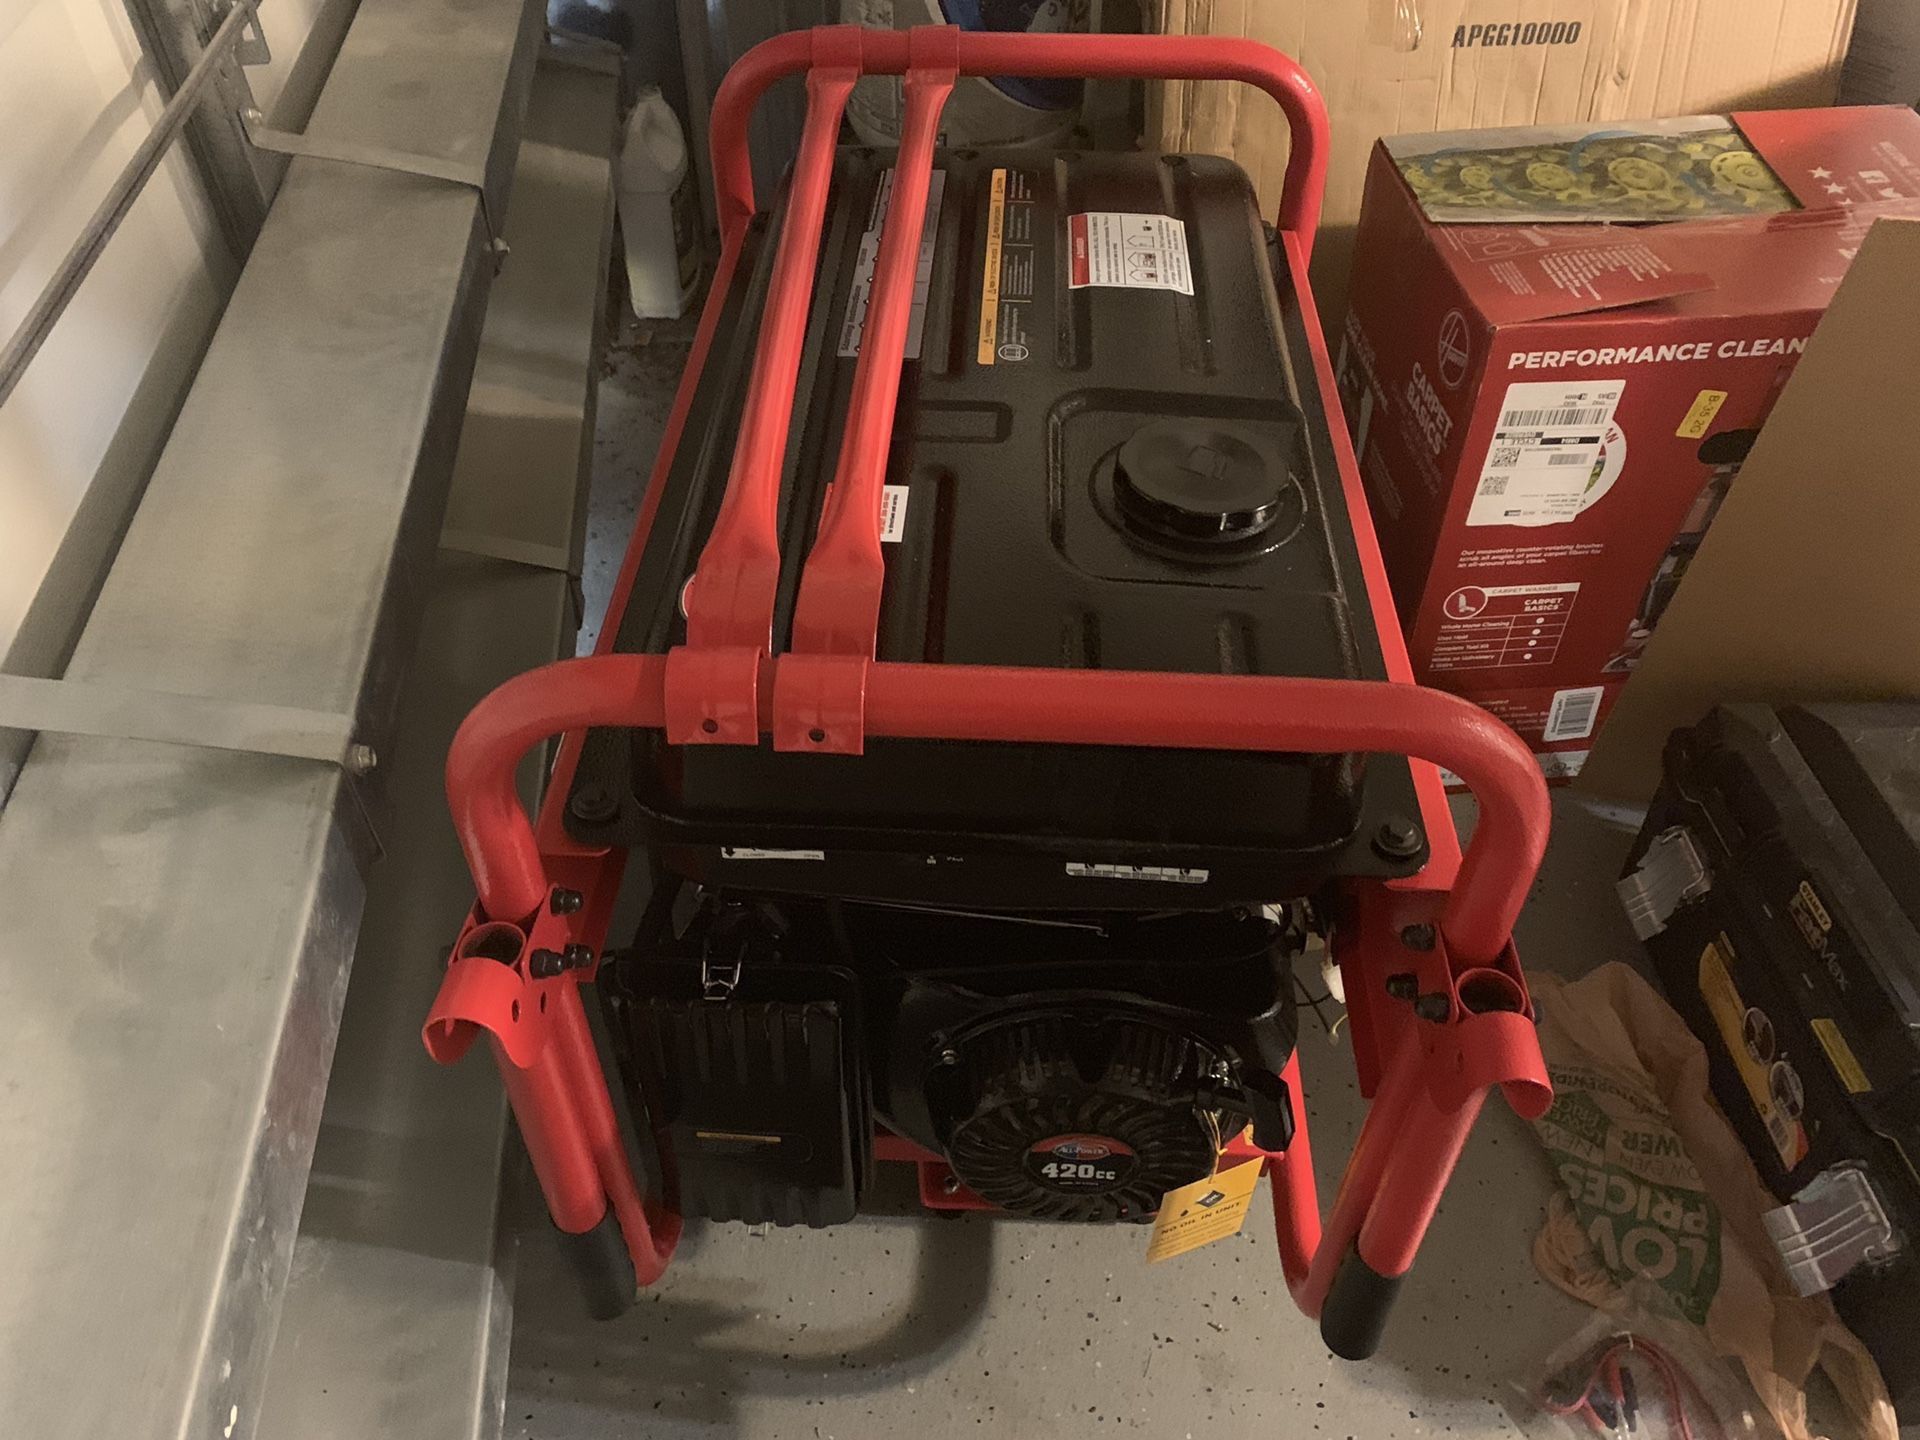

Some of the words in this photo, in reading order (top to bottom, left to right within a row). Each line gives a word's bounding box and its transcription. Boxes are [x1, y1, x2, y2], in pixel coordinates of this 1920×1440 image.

[1450, 21, 1582, 48] APGG10000
[1507, 342, 1713, 370] PERFORMANCE
[1412, 361, 1454, 438] CARPET
[1699, 394, 1721, 418] B-35
[1406, 380, 1442, 455] BASICS
[1511, 438, 1536, 446] CYCLE
[1460, 549, 1476, 557] Our
[1525, 551, 1542, 560] your
[1491, 587, 1523, 595] CARPET
[1524, 597, 1564, 606] CARPET
[1801, 882, 1831, 929] STANLEY
[1621, 1129, 1681, 1157] WER
[1559, 1163, 1709, 1236] PRICES
